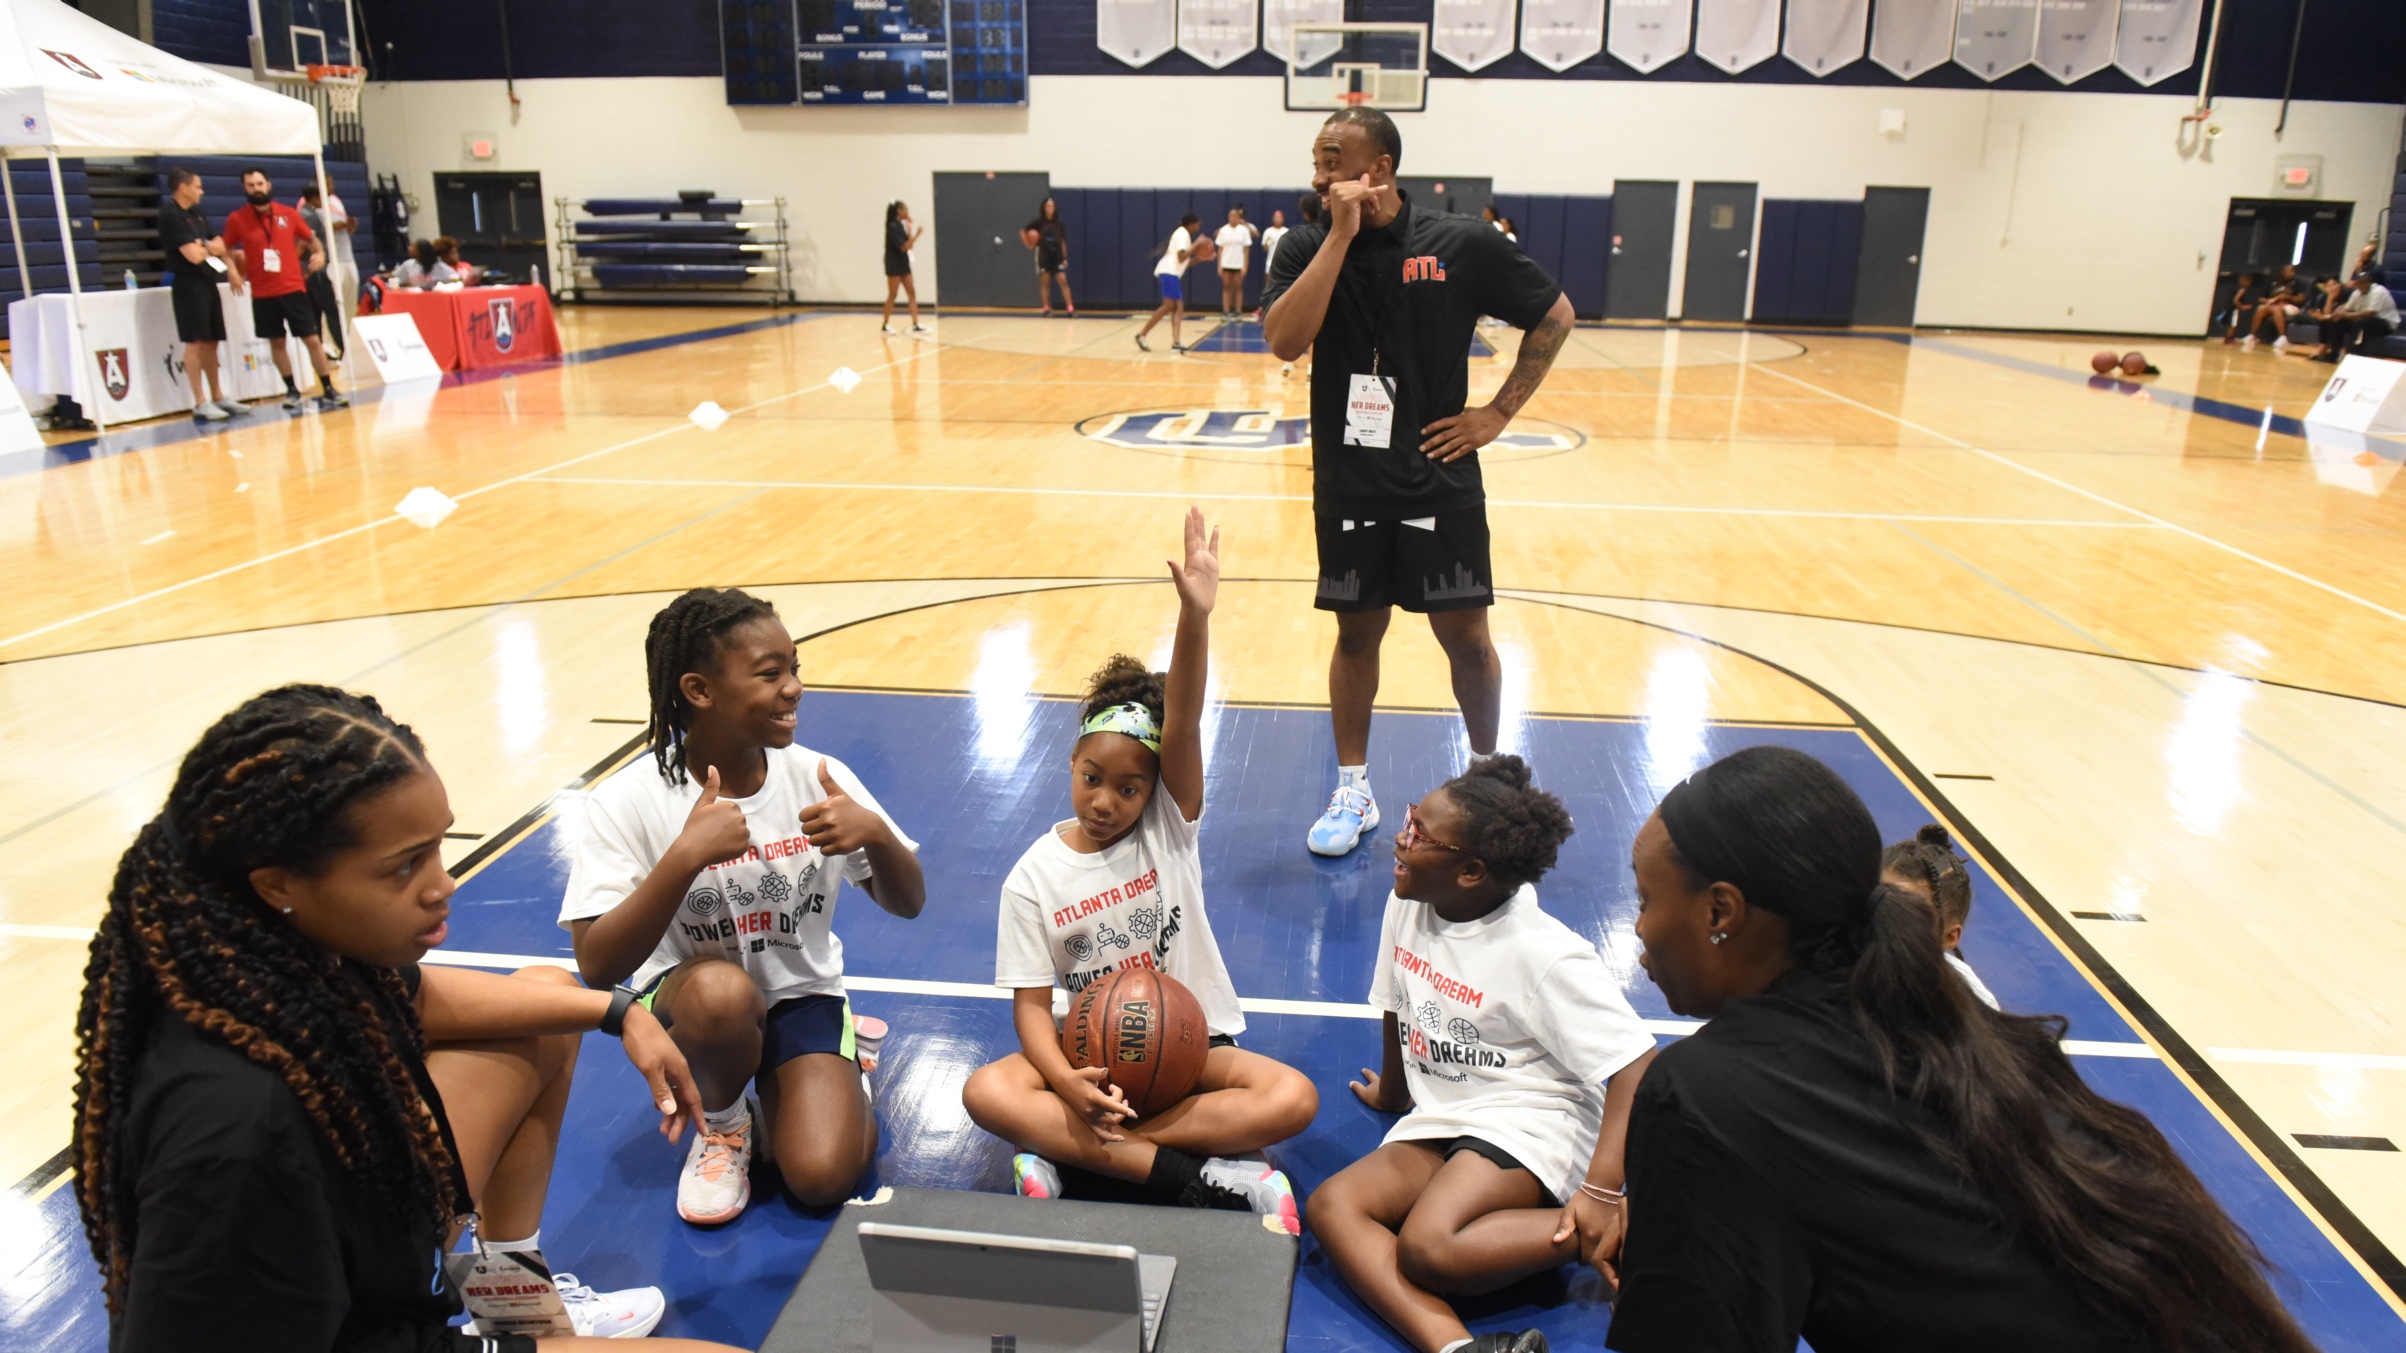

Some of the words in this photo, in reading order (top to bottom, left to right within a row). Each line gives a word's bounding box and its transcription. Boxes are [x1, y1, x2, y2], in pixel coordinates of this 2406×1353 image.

[816, 34, 844, 42] BONUS
[901, 33, 928, 42] BONUS
[799, 51, 824, 60] FOULS
[858, 51, 887, 60] PLAYER
[922, 51, 947, 59] FOULS
[863, 91, 886, 99] GAME
[1403, 256, 1446, 284] ATL
[1351, 401, 1363, 409] HER
[1365, 402, 1390, 412] DREAMS
[1053, 888, 1123, 928] ATLANTA
[1124, 868, 1158, 899] DREA
[736, 911, 772, 936] HER
[1433, 971, 1484, 1009] DREAM
[1075, 982, 1106, 1069] PALDING
[1119, 1000, 1150, 1050] NBA
[466, 1286, 493, 1296] HER
[495, 1284, 550, 1296] DREAMS
